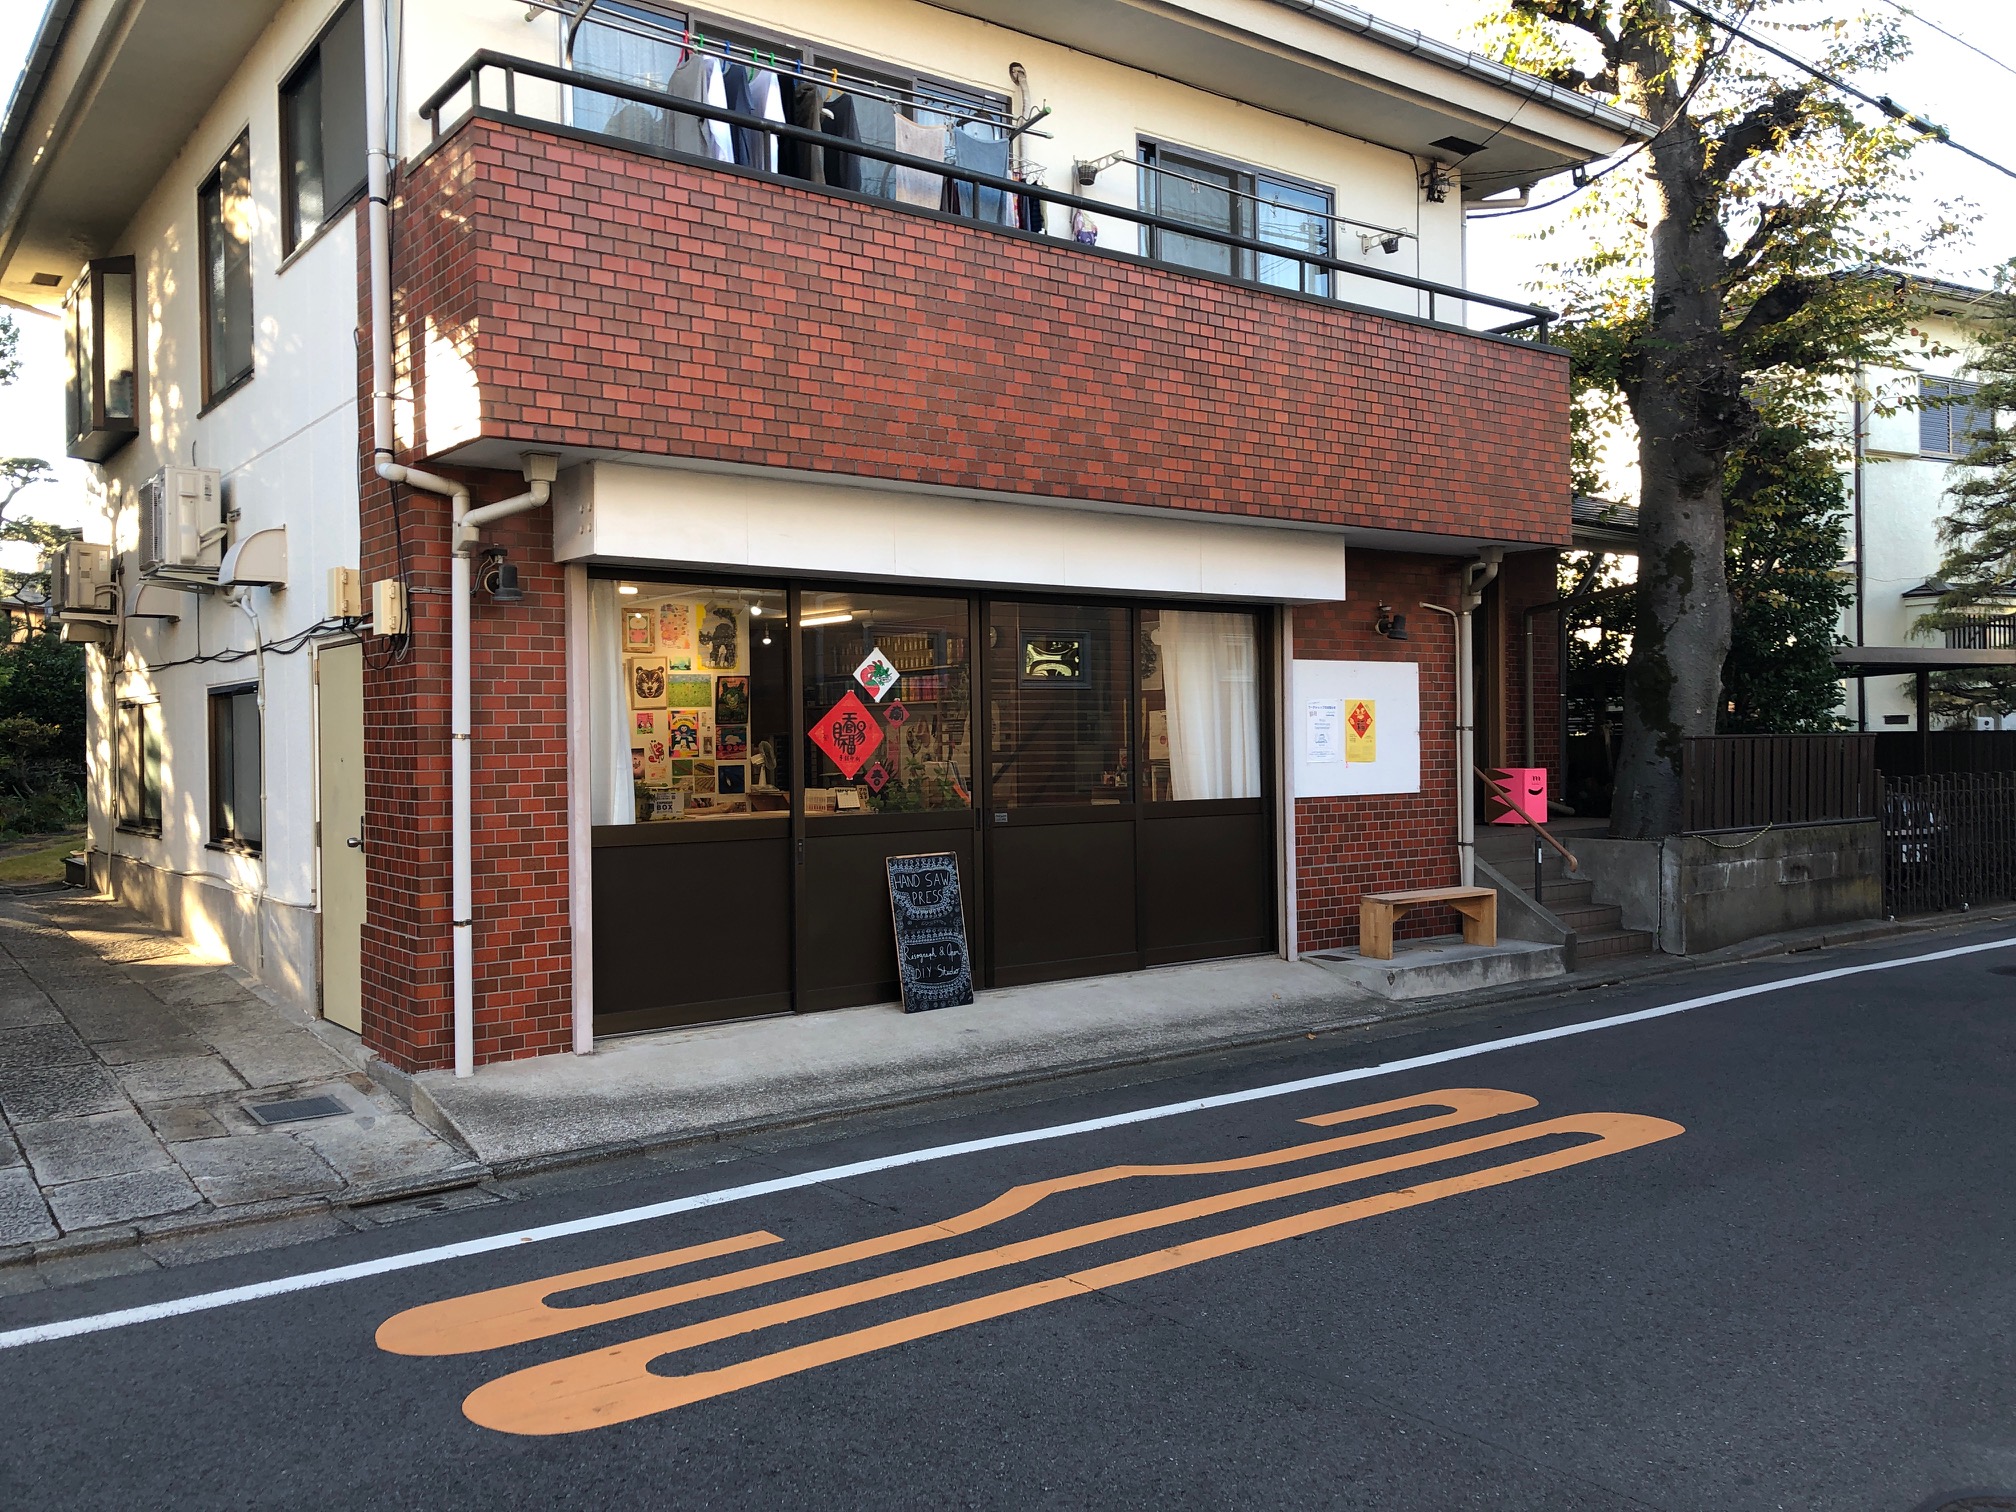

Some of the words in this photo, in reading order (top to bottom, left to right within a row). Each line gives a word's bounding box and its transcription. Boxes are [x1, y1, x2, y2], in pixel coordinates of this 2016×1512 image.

[894, 873, 920, 889] HAND
[924, 872, 949, 888] SAW
[912, 889, 944, 905] PRESS
[939, 946, 945, 956] &
